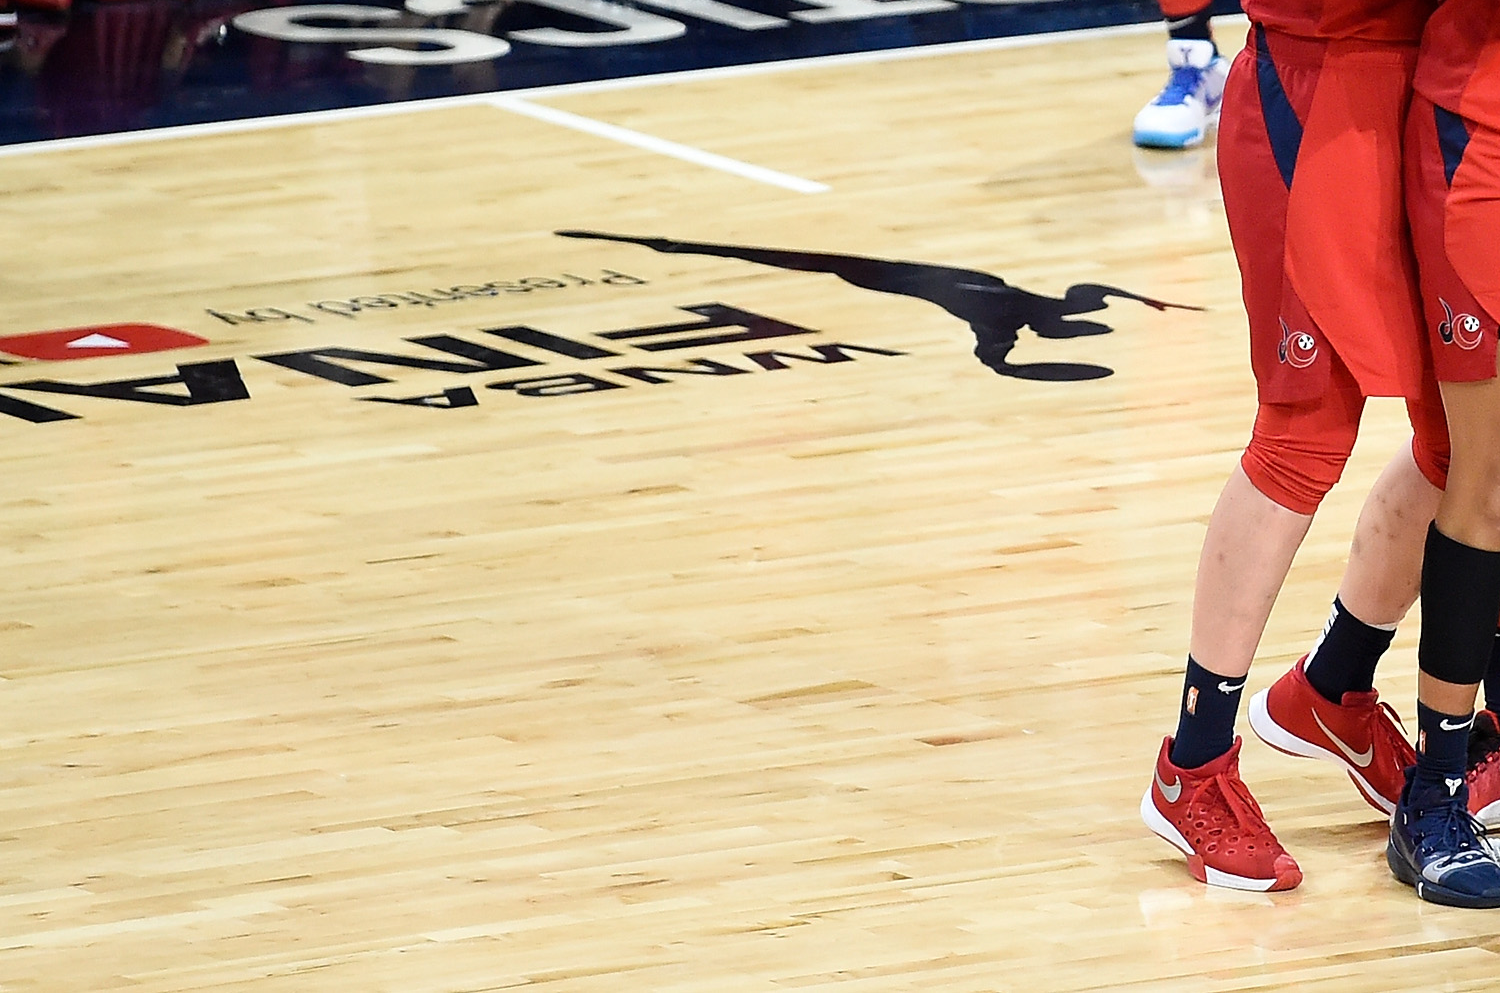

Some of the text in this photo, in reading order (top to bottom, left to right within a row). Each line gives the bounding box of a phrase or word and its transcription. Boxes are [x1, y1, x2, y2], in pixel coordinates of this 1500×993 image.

[205, 269, 649, 326] Presented by
[353, 343, 910, 409] WNBA
